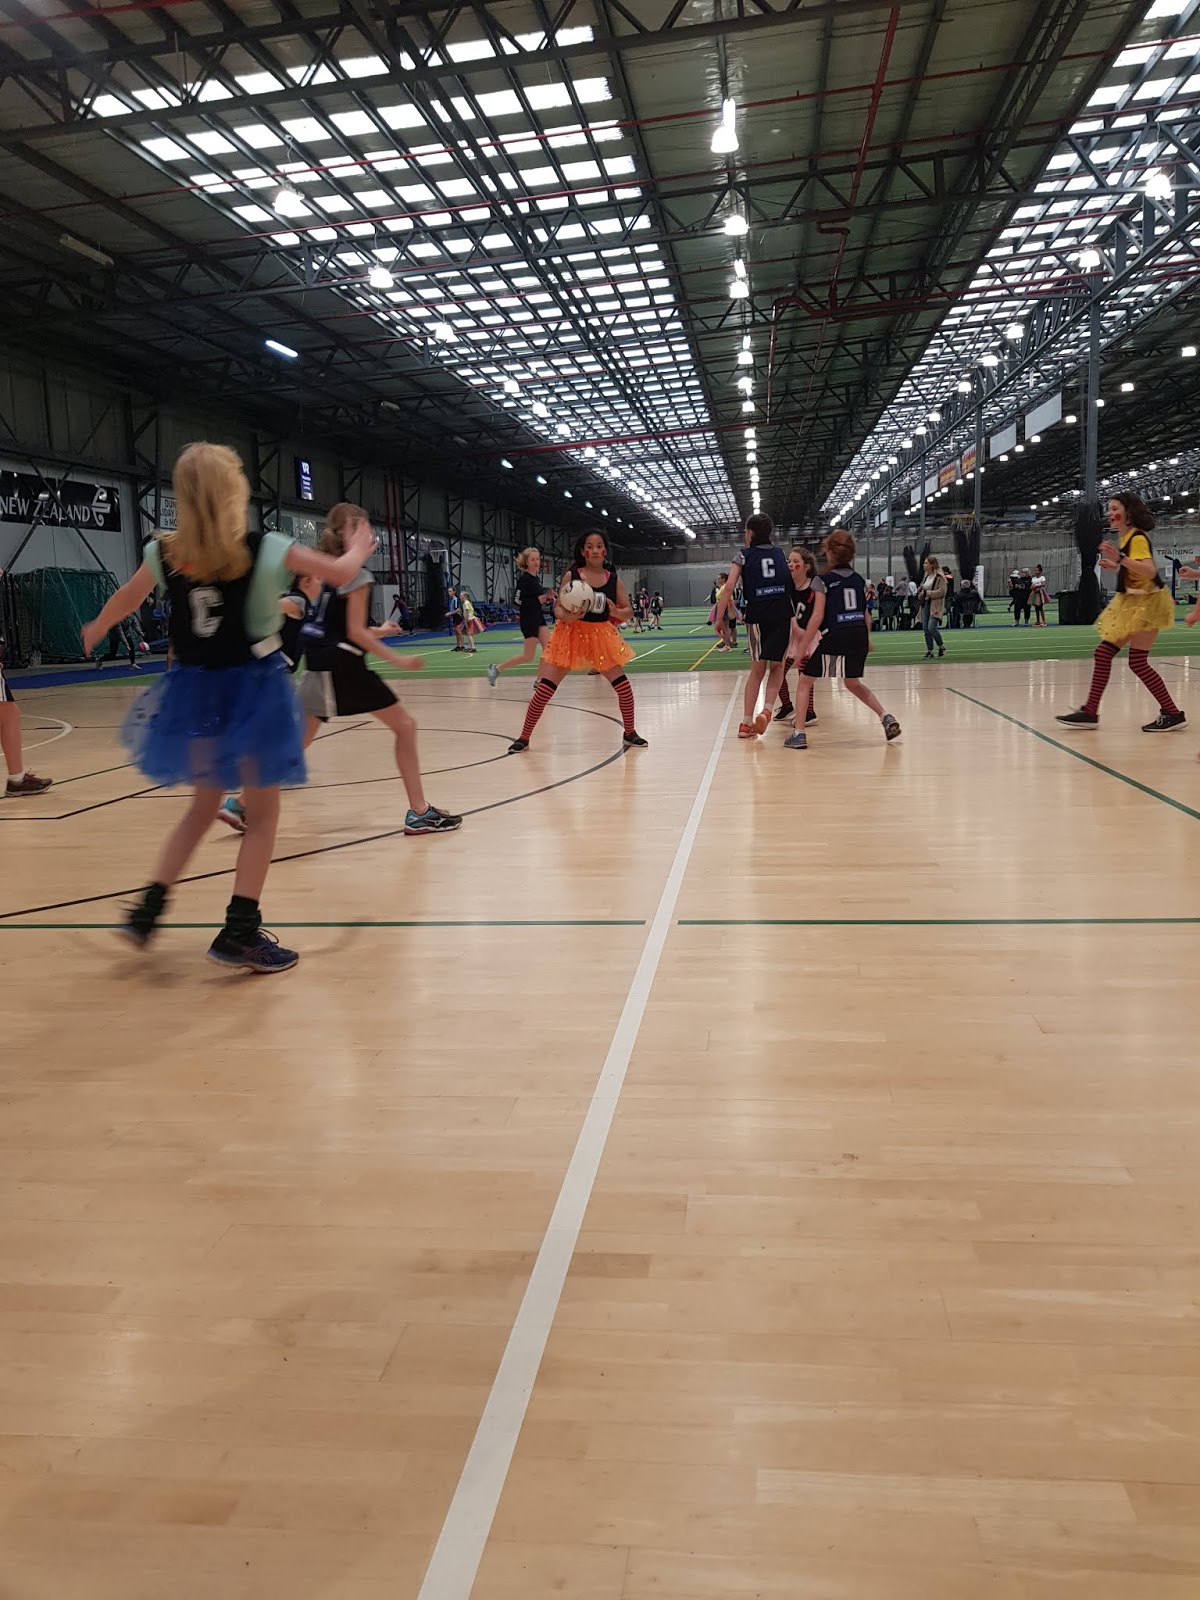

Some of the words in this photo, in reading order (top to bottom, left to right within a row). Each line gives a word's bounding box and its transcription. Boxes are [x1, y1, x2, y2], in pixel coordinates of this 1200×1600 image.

[0, 496, 30, 516] NEW
[33, 500, 91, 522] ZEALAND
[1157, 548, 1194, 556] TRAINING
[761, 558, 776, 578] C
[843, 587, 857, 610] D
[187, 586, 225, 638] C
